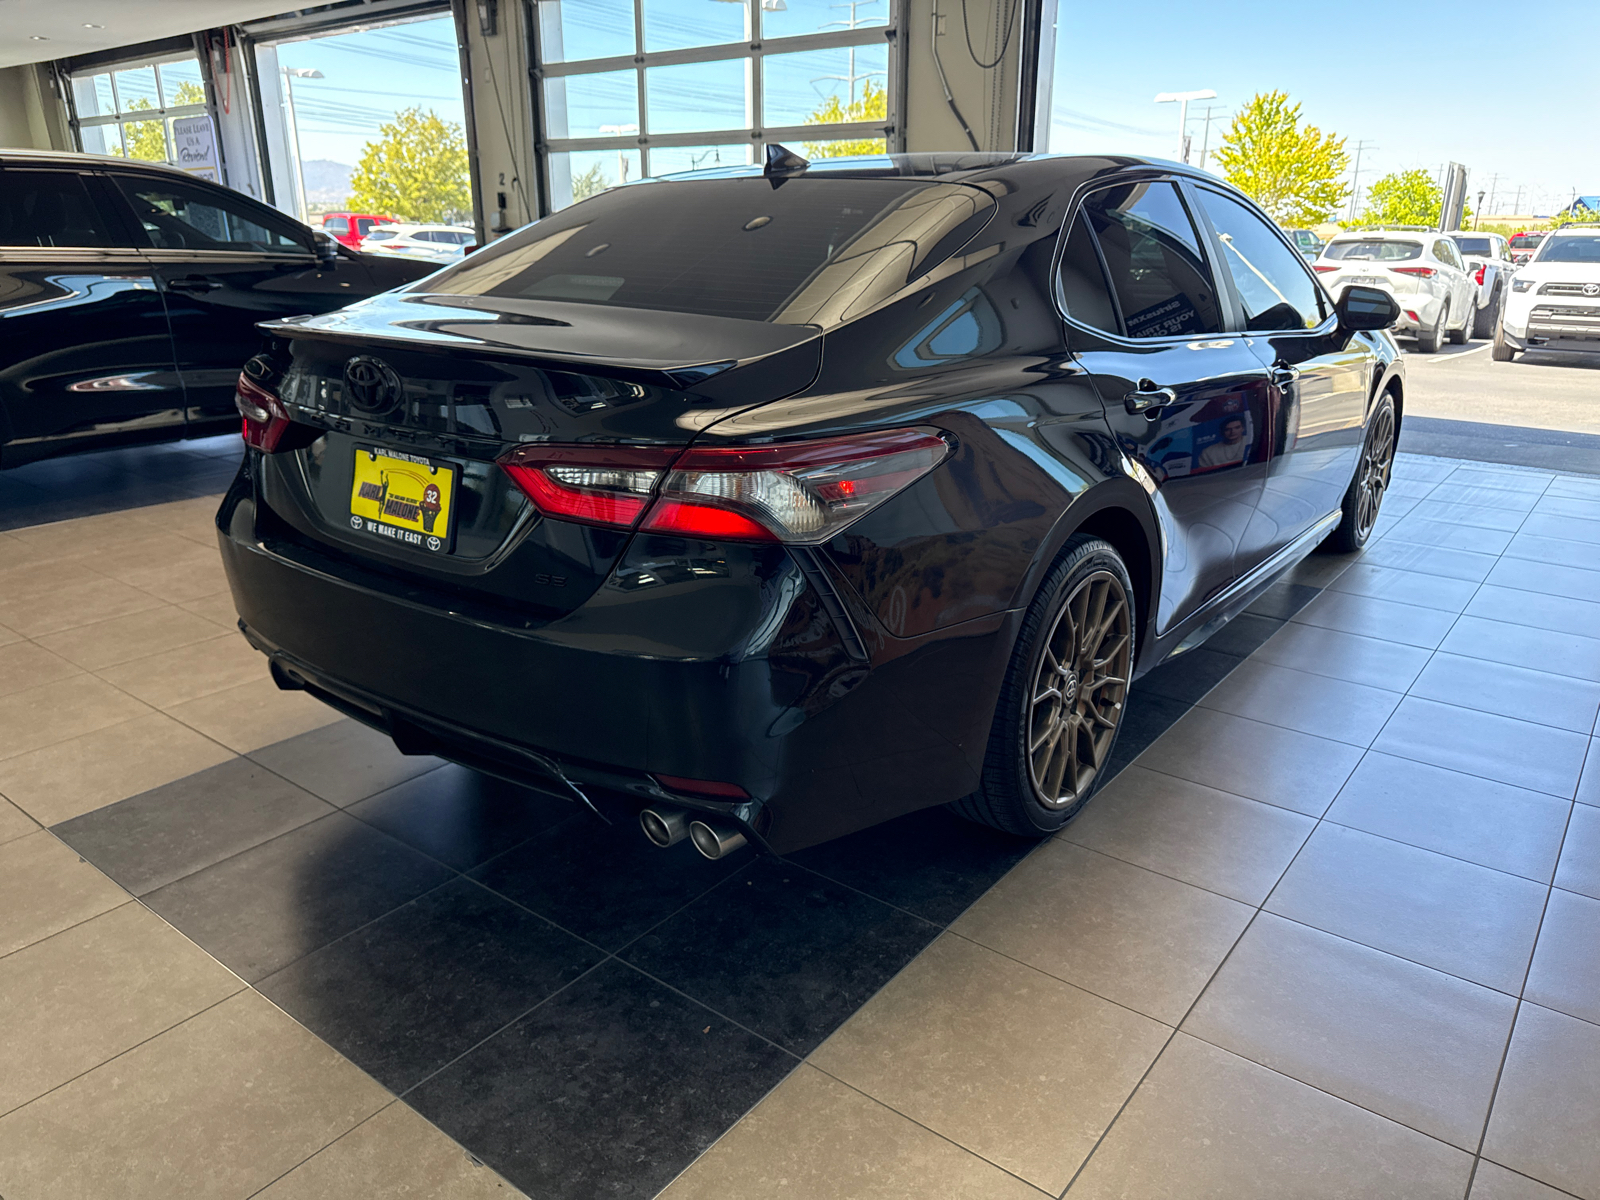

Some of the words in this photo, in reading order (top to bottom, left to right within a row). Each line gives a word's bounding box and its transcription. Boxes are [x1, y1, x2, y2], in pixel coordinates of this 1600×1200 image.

[499, 173, 505, 186] 2
[374, 447, 388, 457] KARL
[388, 450, 410, 462] MALONE
[410, 454, 430, 466] TOYOTA
[358, 481, 383, 502] KARL
[426, 490, 438, 504] 32
[384, 498, 420, 523] MALONE
[367, 521, 377, 532] WE
[378, 524, 396, 538] MAKE
[397, 529, 405, 540] IT
[405, 531, 422, 545] EASY
[534, 573, 568, 588] SE
